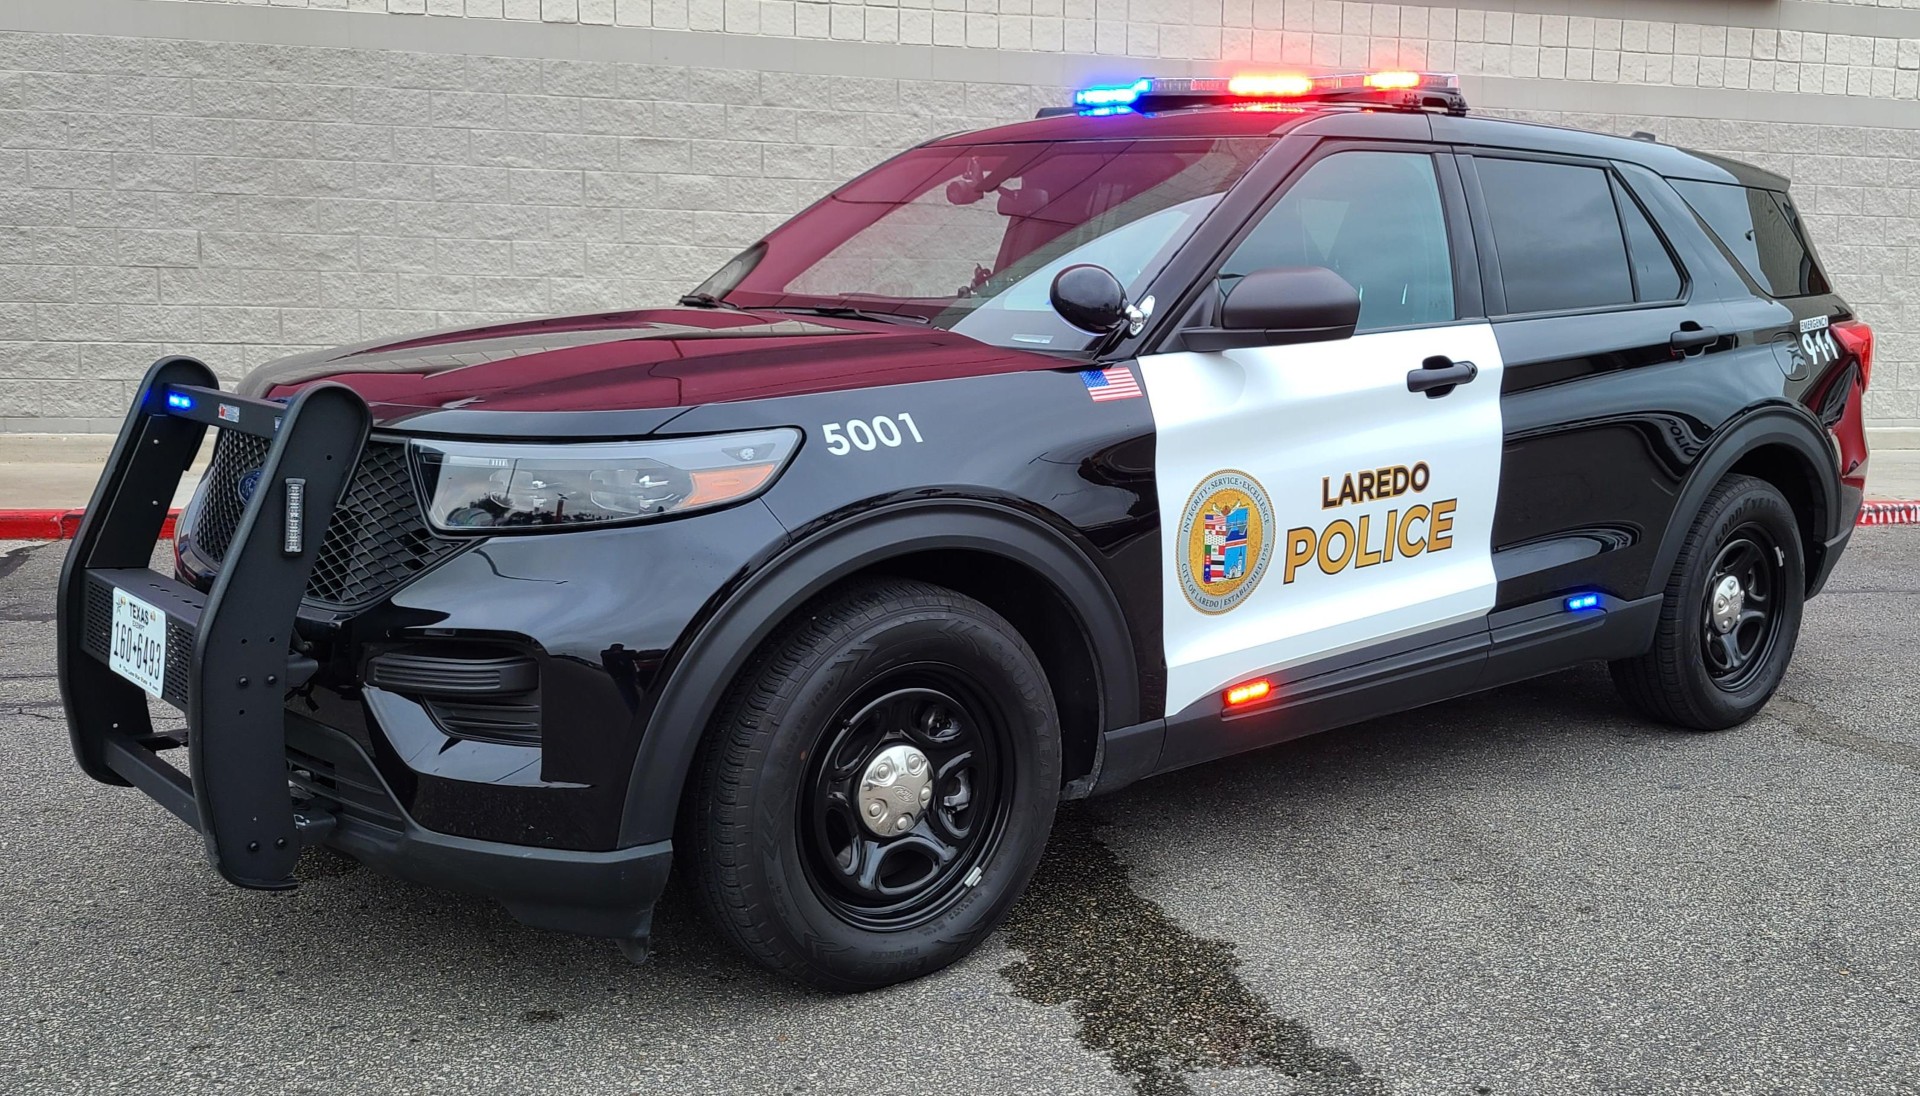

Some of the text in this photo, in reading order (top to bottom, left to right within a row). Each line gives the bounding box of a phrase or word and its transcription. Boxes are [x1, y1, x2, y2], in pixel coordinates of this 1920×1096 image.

[1801, 317, 1827, 331] EMERGENCY
[822, 412, 924, 456] 5001
[1183, 476, 1270, 533] INTEGRITY SERVICE EXCELLENCE
[1321, 460, 1430, 510] LAREDO
[1283, 497, 1457, 584] POLICE
[1181, 563, 1190, 584] CITY
[1188, 584, 1197, 596] OF
[1194, 593, 1219, 608] LAREDO
[1224, 563, 1263, 606] ESTABLISHED
[129, 601, 149, 626] TEXAS
